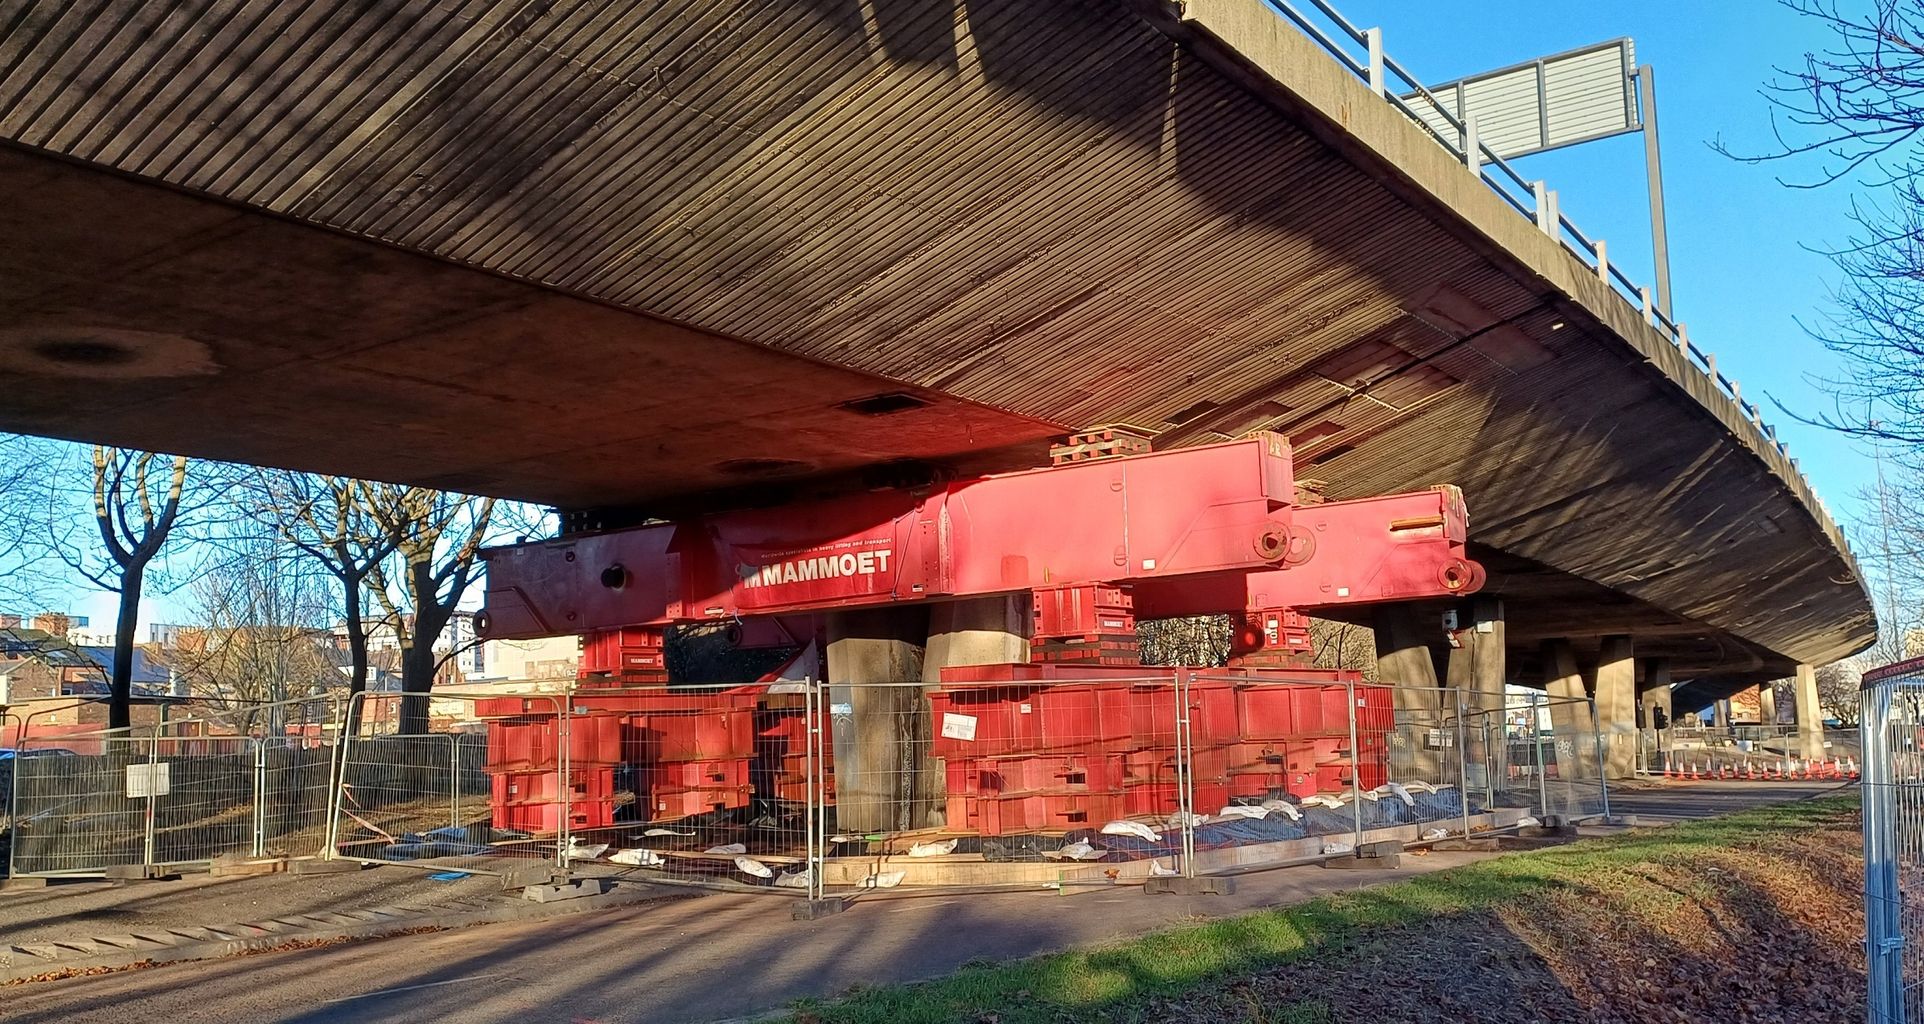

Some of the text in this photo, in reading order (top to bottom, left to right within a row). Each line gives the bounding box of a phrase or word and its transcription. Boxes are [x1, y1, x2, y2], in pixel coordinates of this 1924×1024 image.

[835, 541, 852, 549] lifting
[864, 537, 892, 546] transport
[762, 550, 891, 586] MAMMOET
